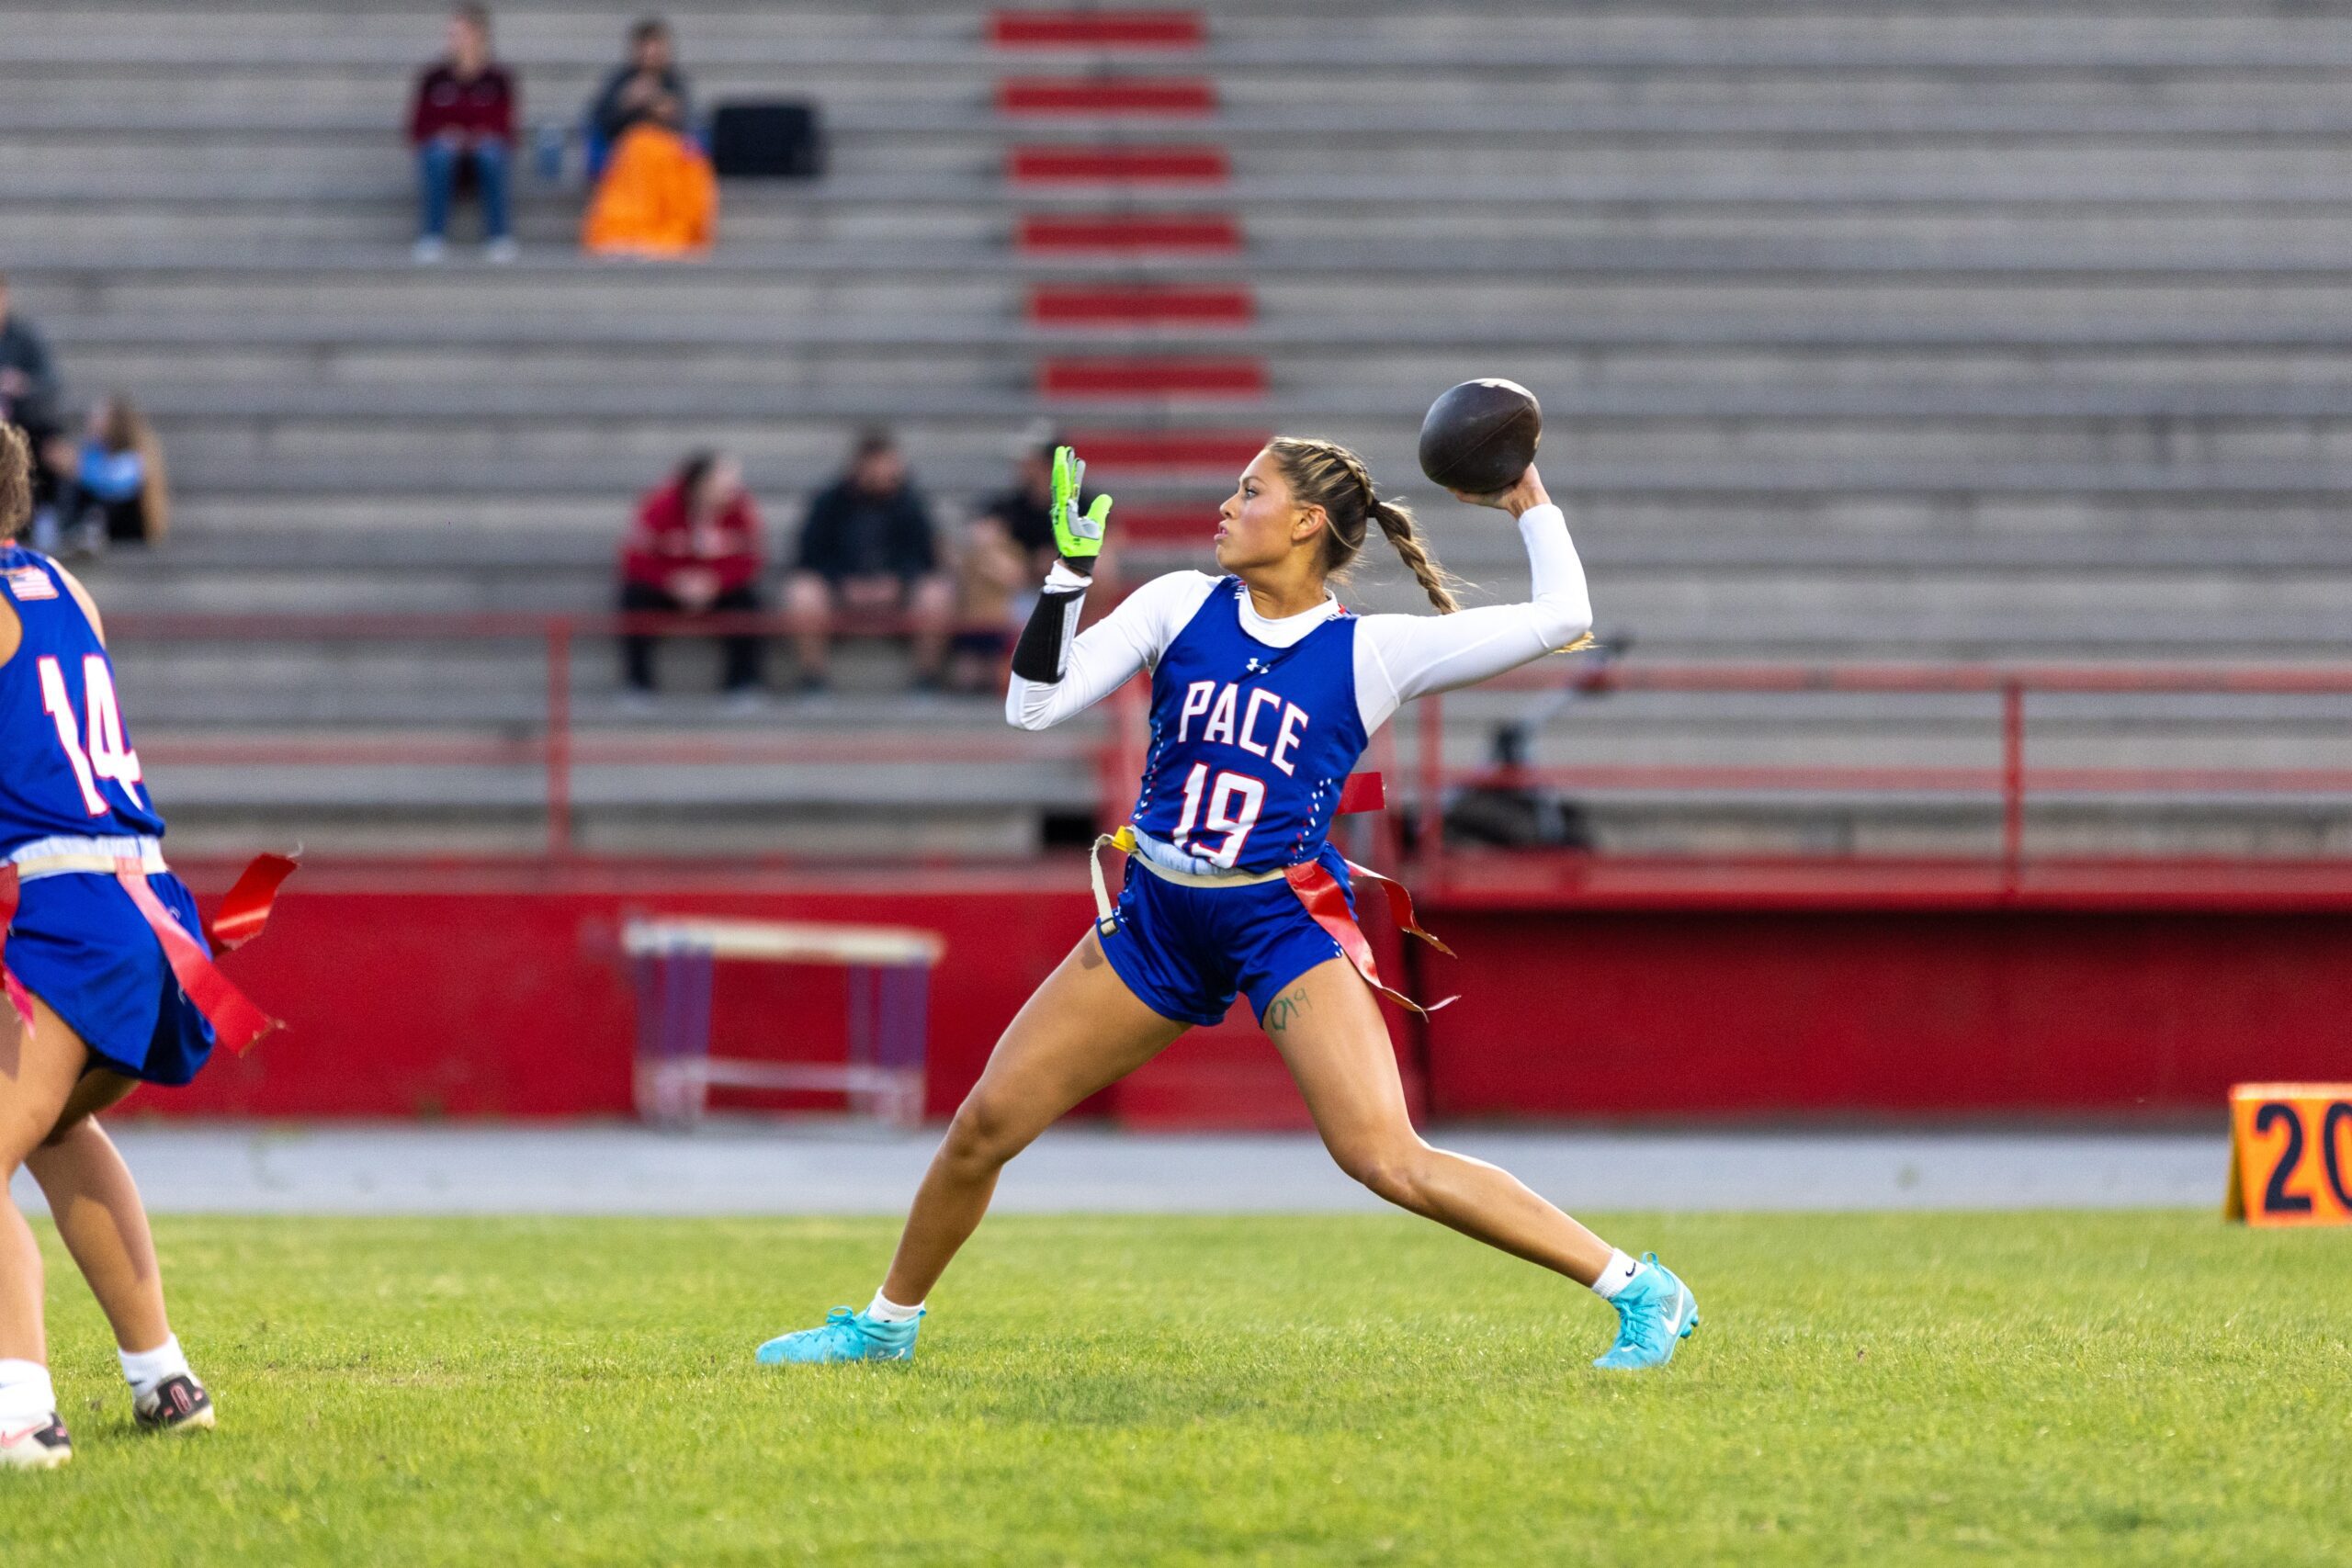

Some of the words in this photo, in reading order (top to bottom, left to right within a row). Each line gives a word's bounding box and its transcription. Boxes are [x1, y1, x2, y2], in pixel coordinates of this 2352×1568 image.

[37, 655, 142, 818] 14
[1178, 680, 1308, 776] PACE
[1171, 760, 1267, 869] 19
